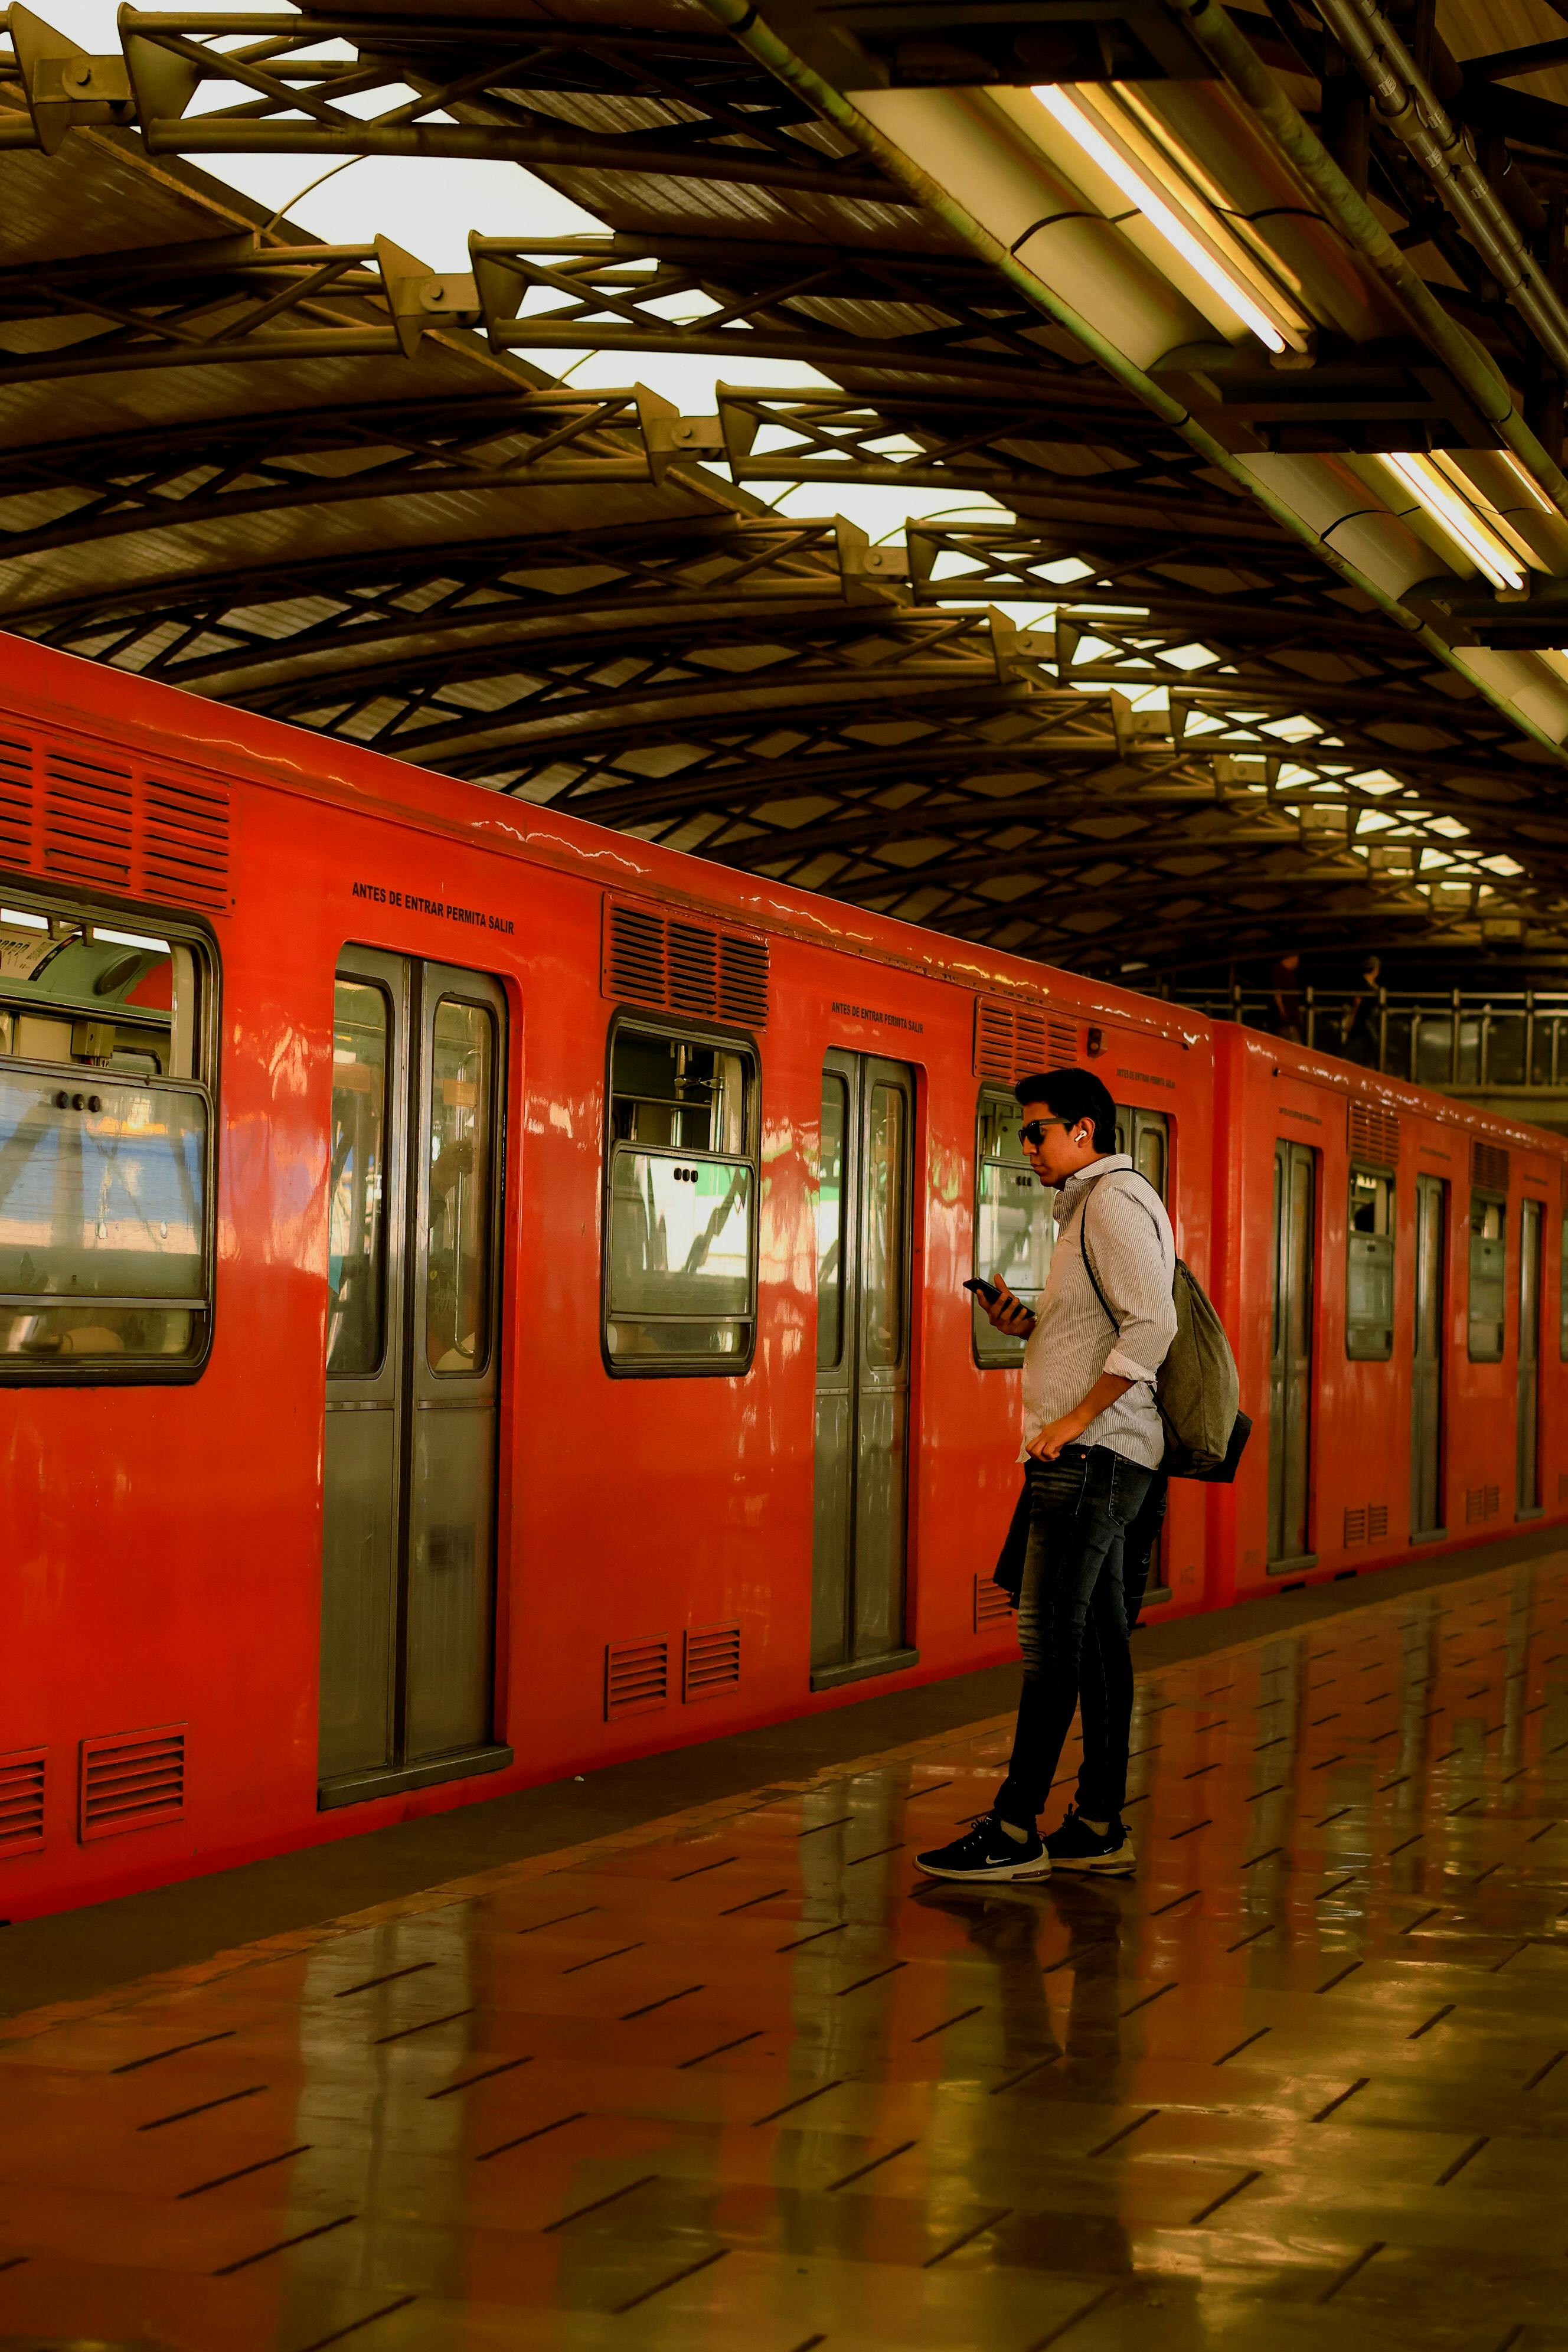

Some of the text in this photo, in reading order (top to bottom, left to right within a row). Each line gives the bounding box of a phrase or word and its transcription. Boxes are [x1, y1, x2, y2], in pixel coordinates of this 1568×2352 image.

[352, 882, 514, 935] ANTES DE ENTRAR PERMITA SALIR
[831, 1002, 923, 1034] ANTES DE ENTRAR PERMITA SALIR
